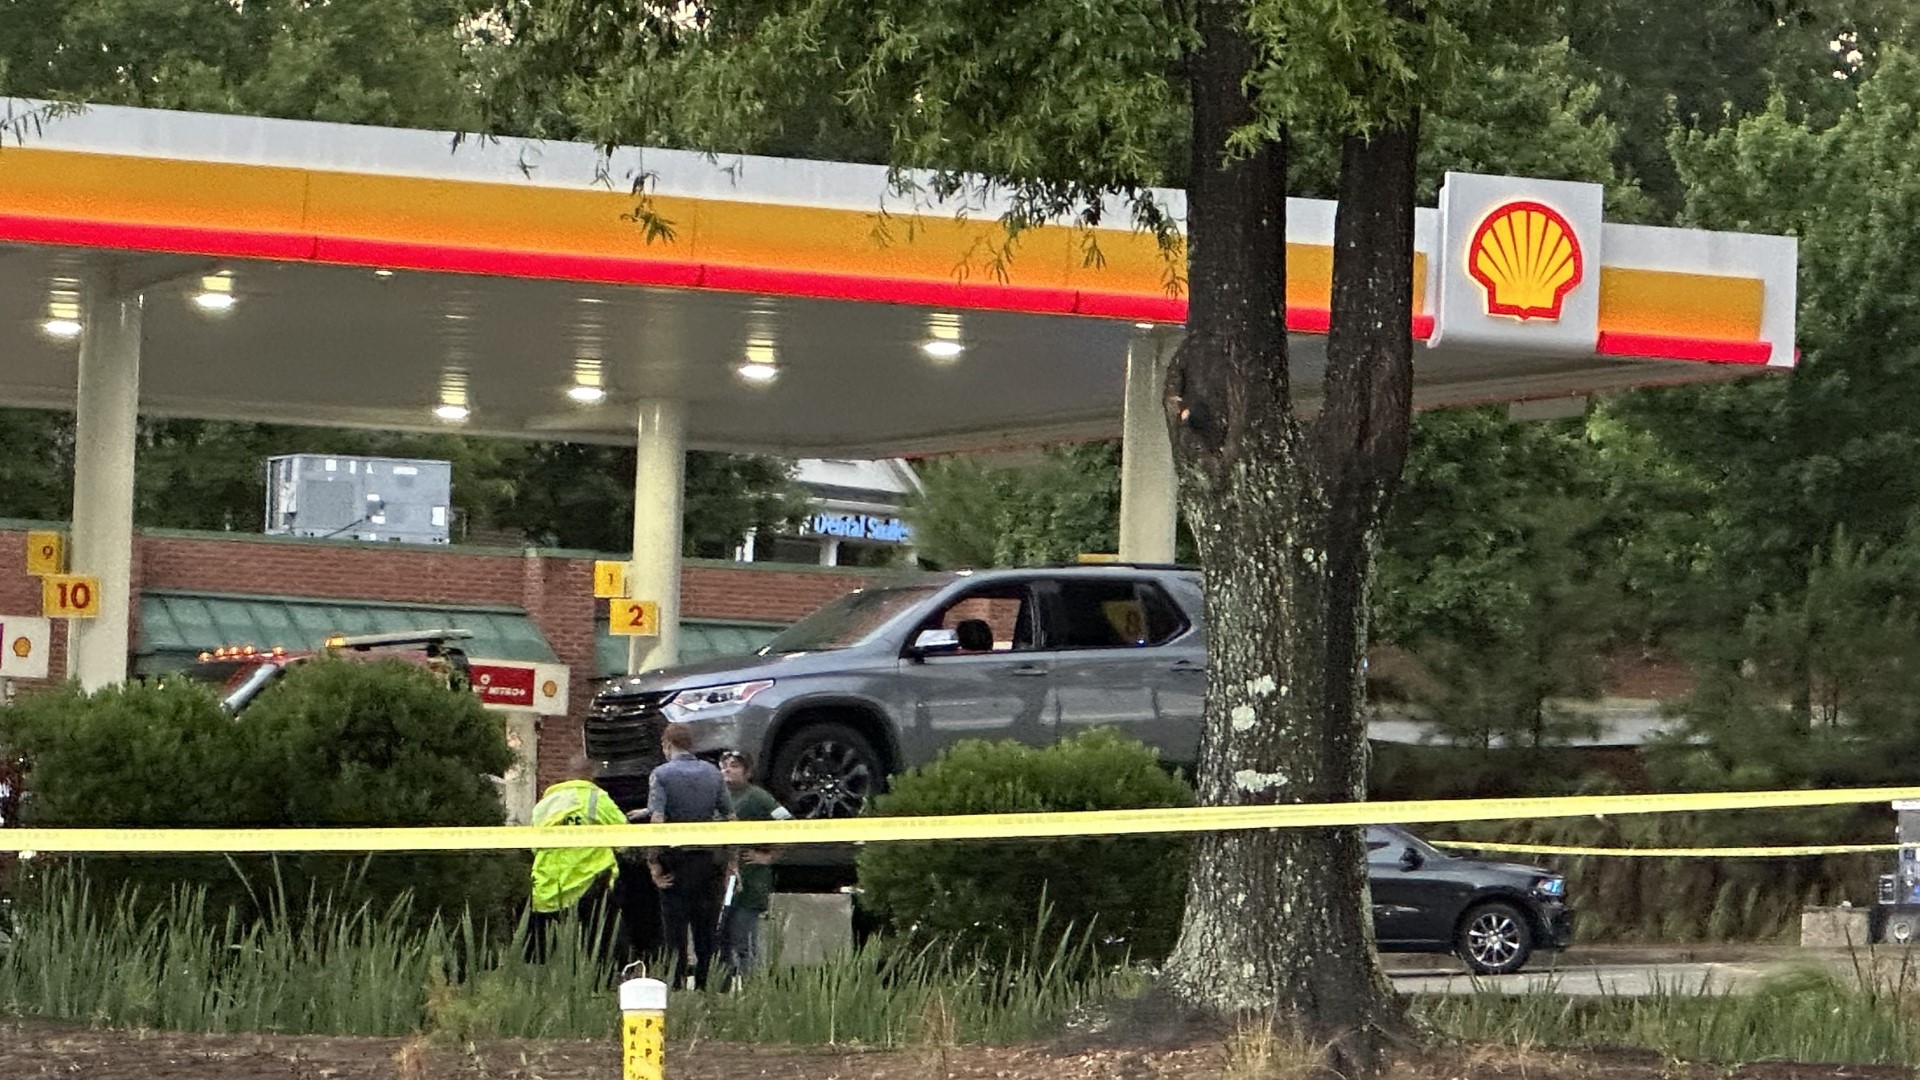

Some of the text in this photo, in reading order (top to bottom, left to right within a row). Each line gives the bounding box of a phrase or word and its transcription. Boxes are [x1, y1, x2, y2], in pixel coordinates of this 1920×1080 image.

[813, 512, 866, 538] Dental
[42, 545, 54, 560] 9
[607, 573, 614, 586] 1
[57, 582, 91, 609] 10
[628, 604, 644, 627] 2
